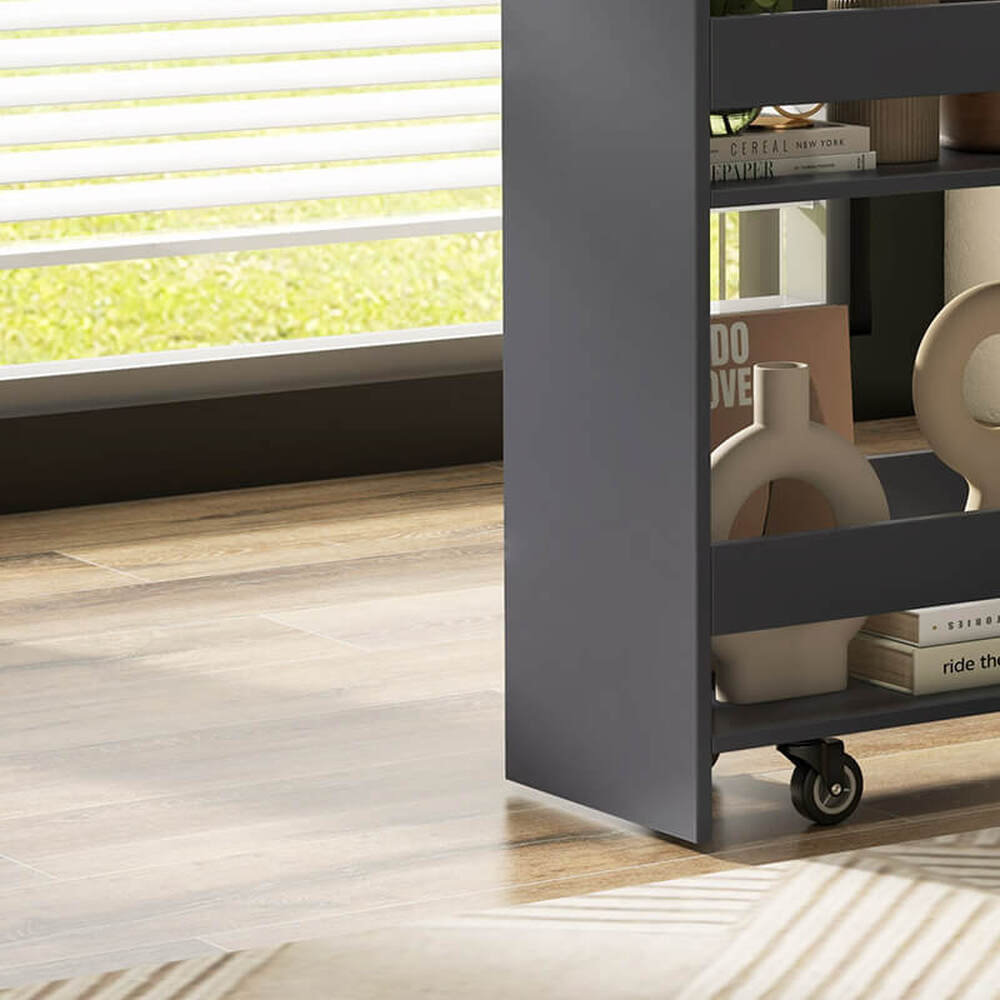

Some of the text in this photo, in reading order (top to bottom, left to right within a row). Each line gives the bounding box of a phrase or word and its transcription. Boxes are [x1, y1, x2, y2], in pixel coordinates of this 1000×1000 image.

[730, 137, 845, 157] CEREAL NEW YORK
[710, 321, 749, 367] DO
[942, 656, 976, 676] ride
